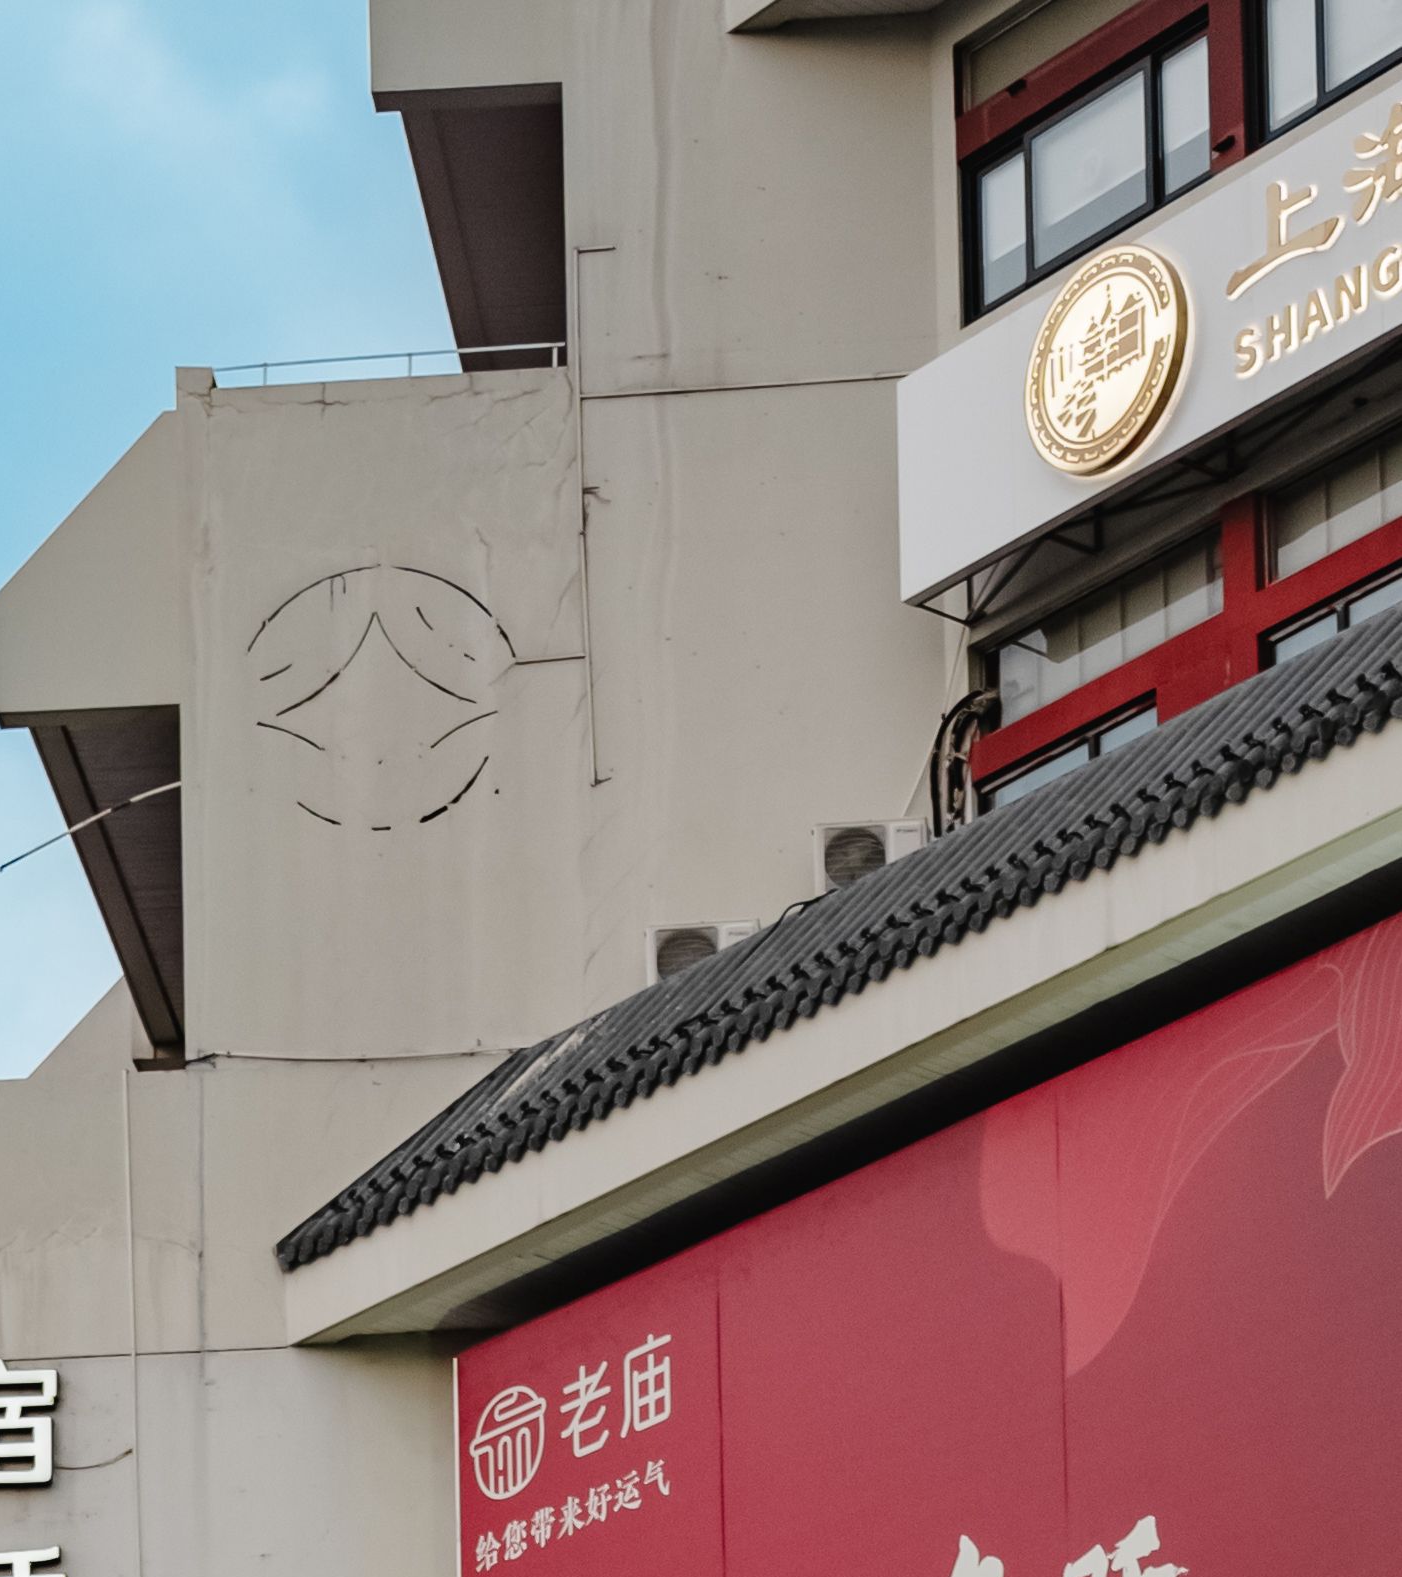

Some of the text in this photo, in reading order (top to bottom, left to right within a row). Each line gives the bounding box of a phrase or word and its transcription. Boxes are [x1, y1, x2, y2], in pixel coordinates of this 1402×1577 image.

[559, 1333, 672, 1458] 老庙
[475, 1459, 670, 1573] 给您带来好运气
